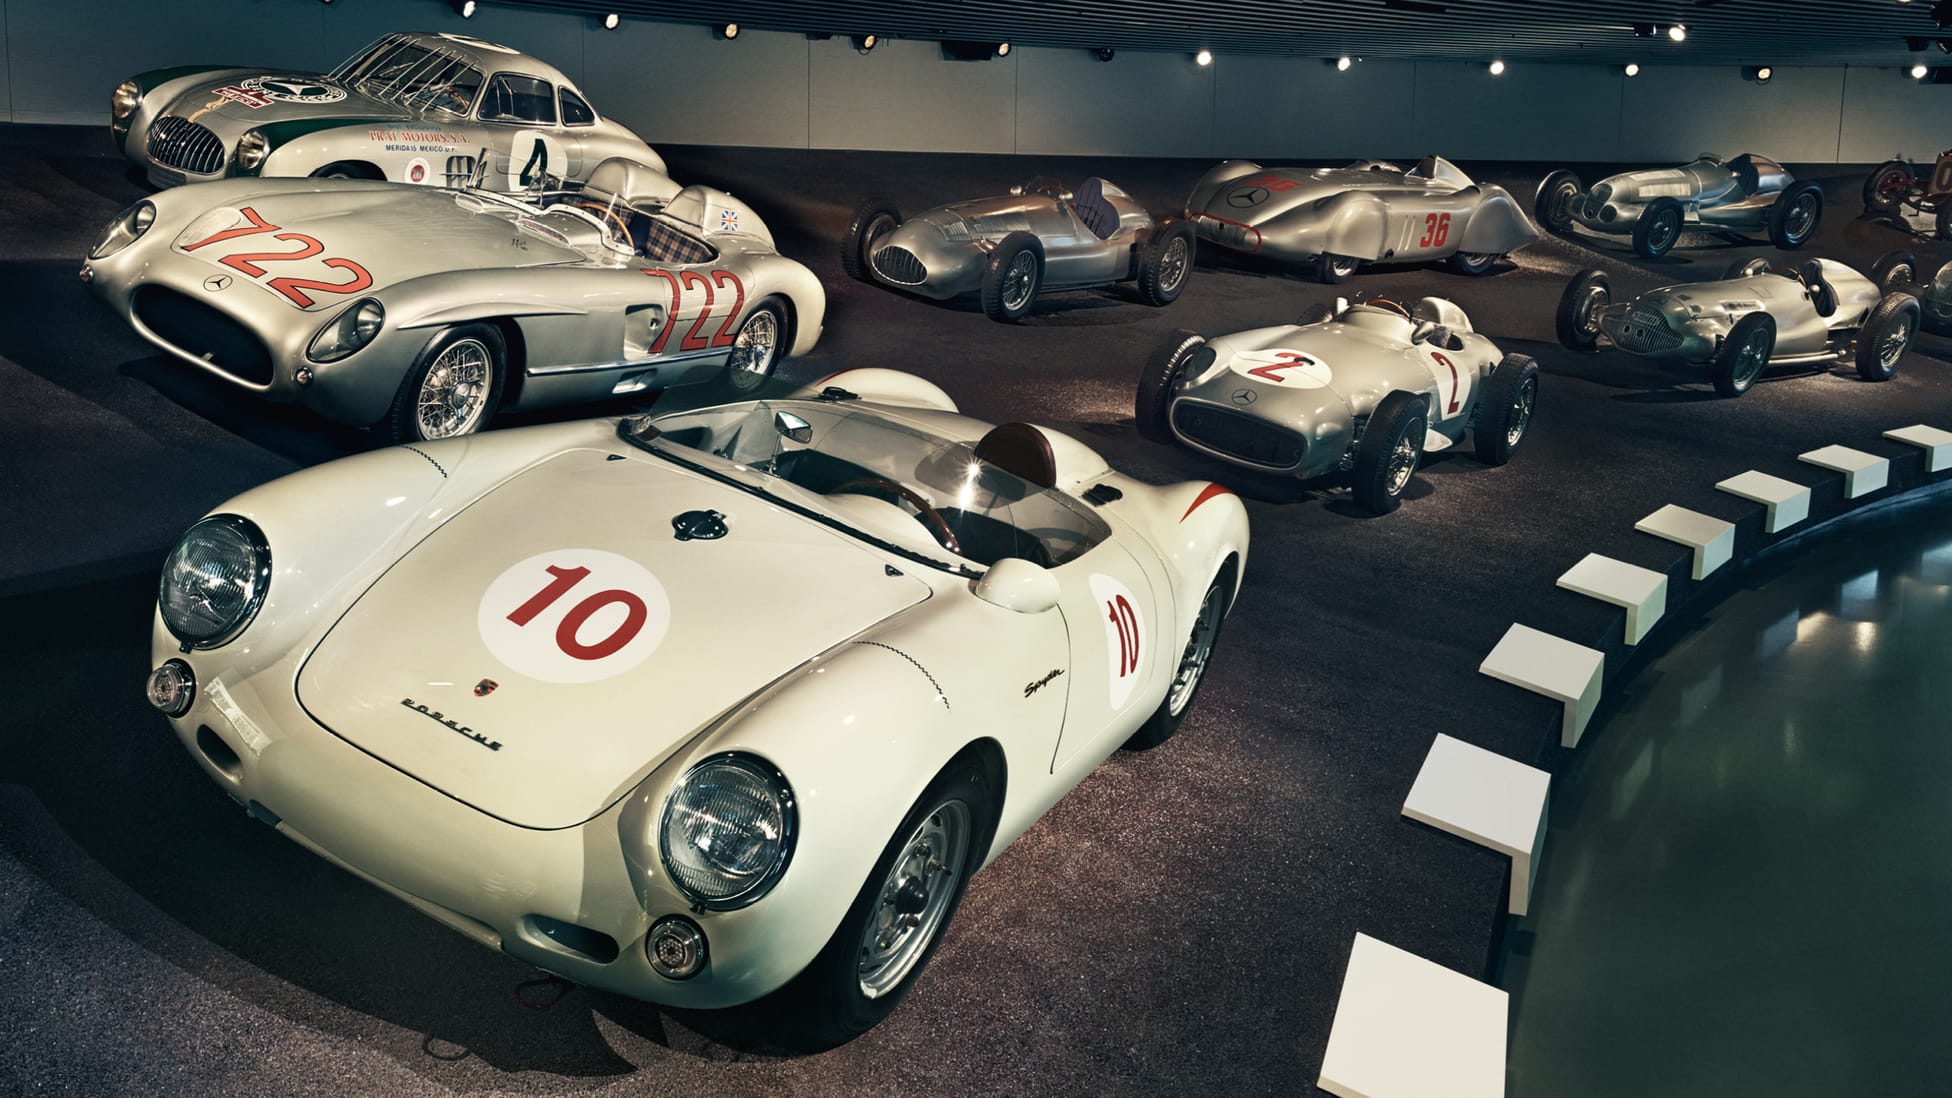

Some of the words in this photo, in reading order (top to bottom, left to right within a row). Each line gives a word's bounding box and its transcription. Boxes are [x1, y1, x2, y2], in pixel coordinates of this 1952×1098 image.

[385, 144, 409, 152] MERIDA
[519, 138, 549, 187] 4
[1247, 175, 1303, 193] 36
[1419, 212, 1451, 248] 36
[179, 206, 374, 309] 722
[640, 269, 745, 354] 722
[1247, 352, 1307, 383] 2
[1431, 351, 1459, 414] 2
[506, 564, 648, 661] 10
[1107, 594, 1140, 678] 10
[1024, 668, 1065, 698] Spyder
[400, 698, 503, 752] PORSCHE
